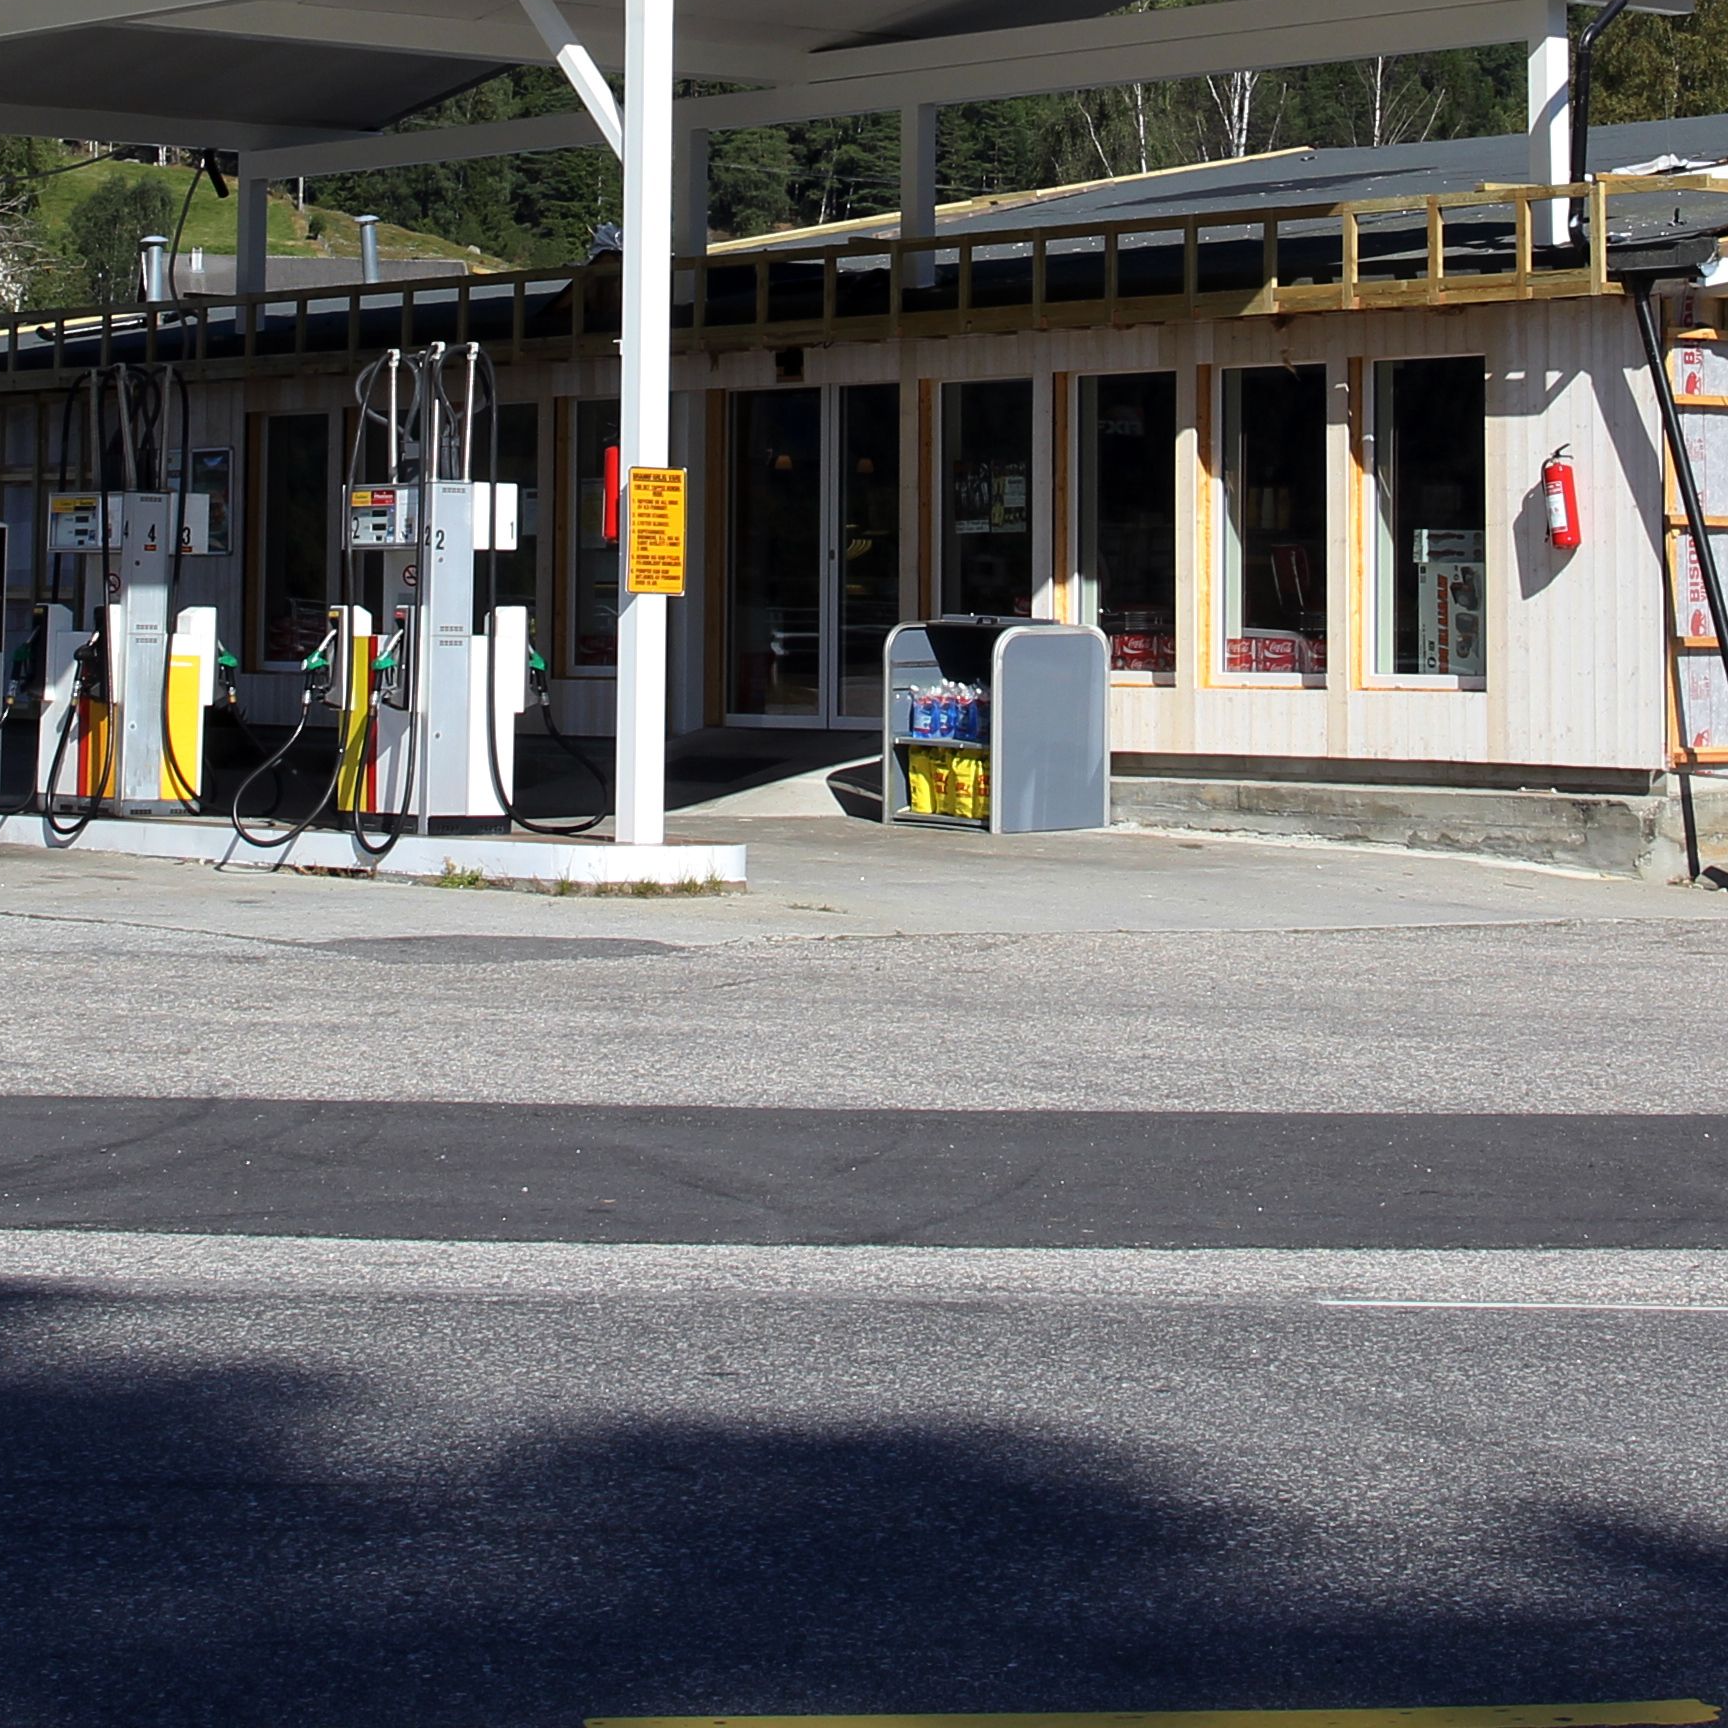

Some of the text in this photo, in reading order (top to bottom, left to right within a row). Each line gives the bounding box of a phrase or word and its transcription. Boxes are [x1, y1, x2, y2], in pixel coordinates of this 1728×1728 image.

[148, 524, 156, 543] 4
[182, 527, 191, 545] 3
[353, 517, 360, 539] 2
[425, 526, 431, 546] 2
[435, 530, 445, 550] 2
